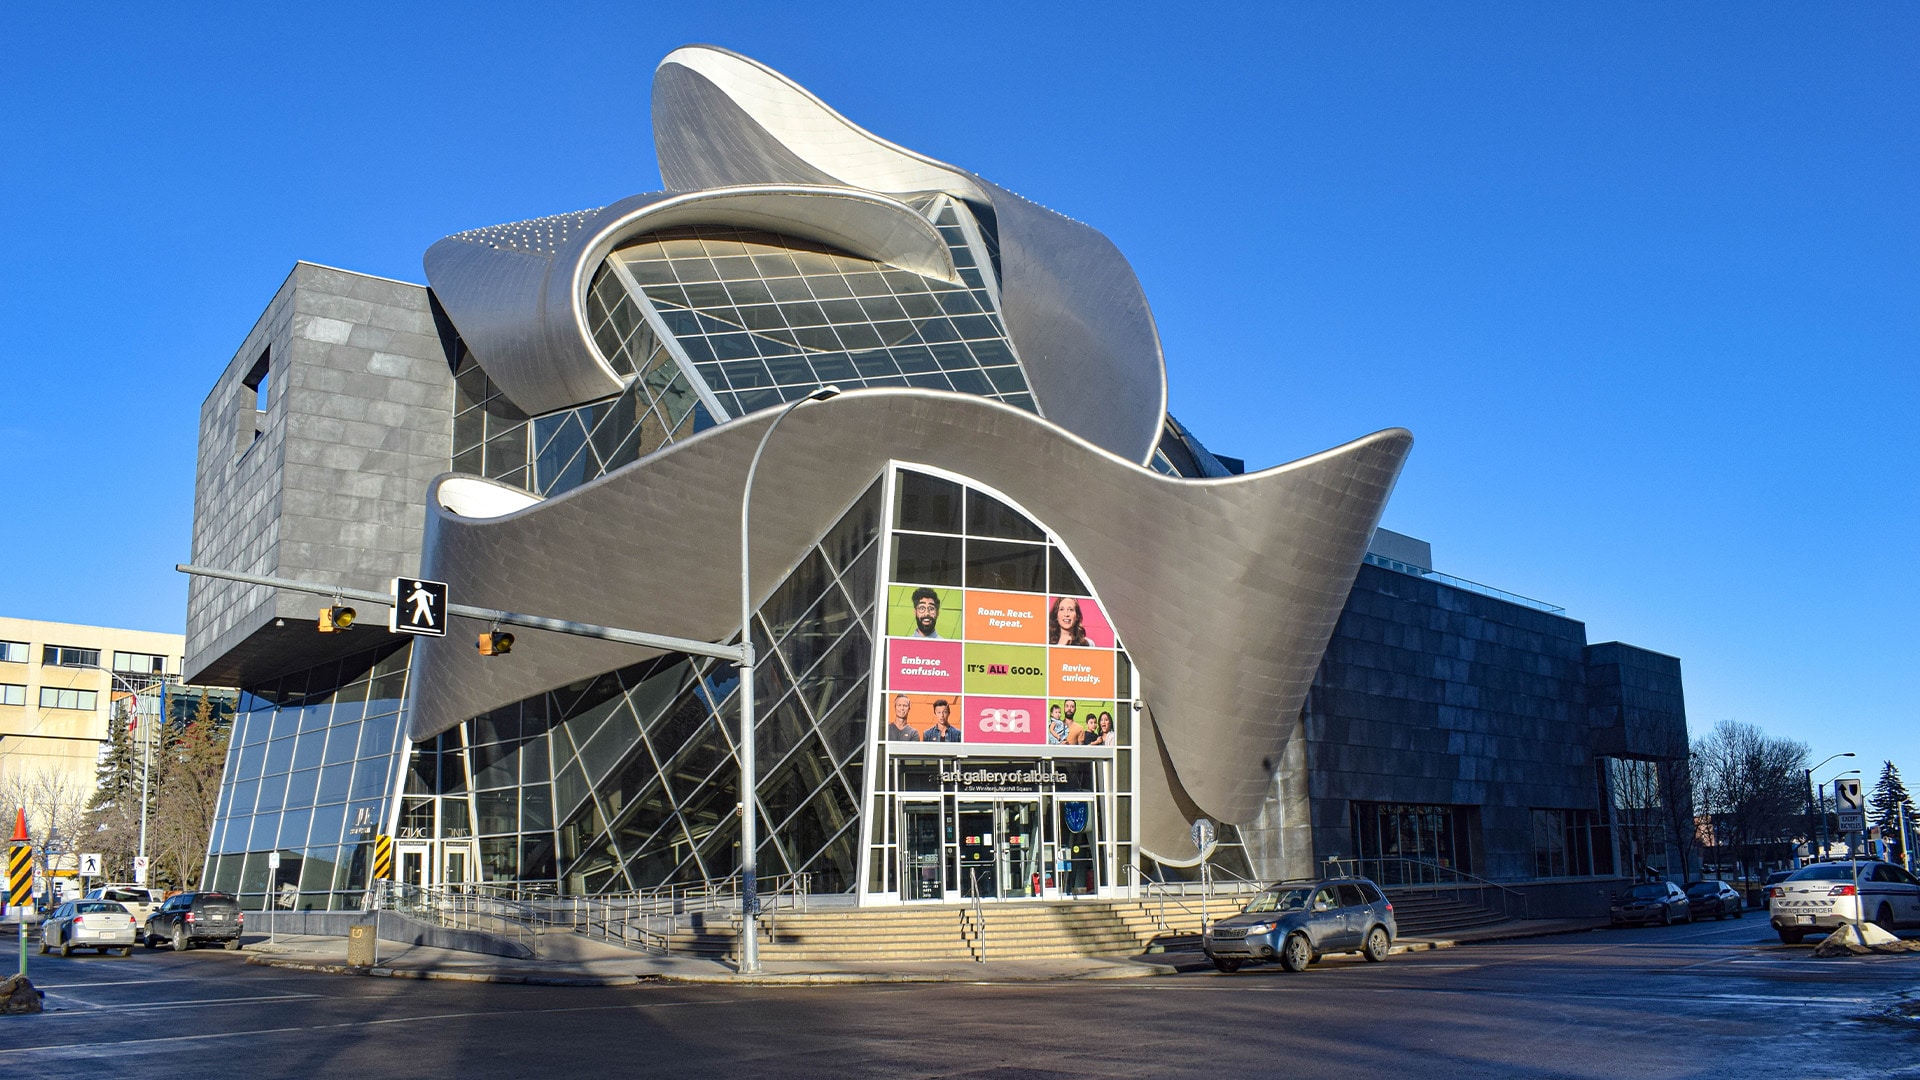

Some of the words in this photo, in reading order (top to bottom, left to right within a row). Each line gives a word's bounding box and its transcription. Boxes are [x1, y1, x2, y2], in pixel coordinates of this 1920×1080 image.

[977, 607, 1005, 617] Roam.
[1006, 609, 1034, 619] React.
[988, 618, 1023, 629] Repeat.
[901, 656, 941, 667] Embrace
[901, 666, 950, 677] confusion.
[967, 664, 985, 674] IT'S
[989, 664, 1007, 674] ALL
[1010, 665, 1043, 676] GOOD.
[1062, 663, 1091, 674] Revive
[1062, 673, 1101, 685] curiosity.
[942, 771, 961, 782] art
[963, 769, 1007, 785] gallery
[1008, 770, 1021, 782] of
[1022, 769, 1068, 783] alberta
